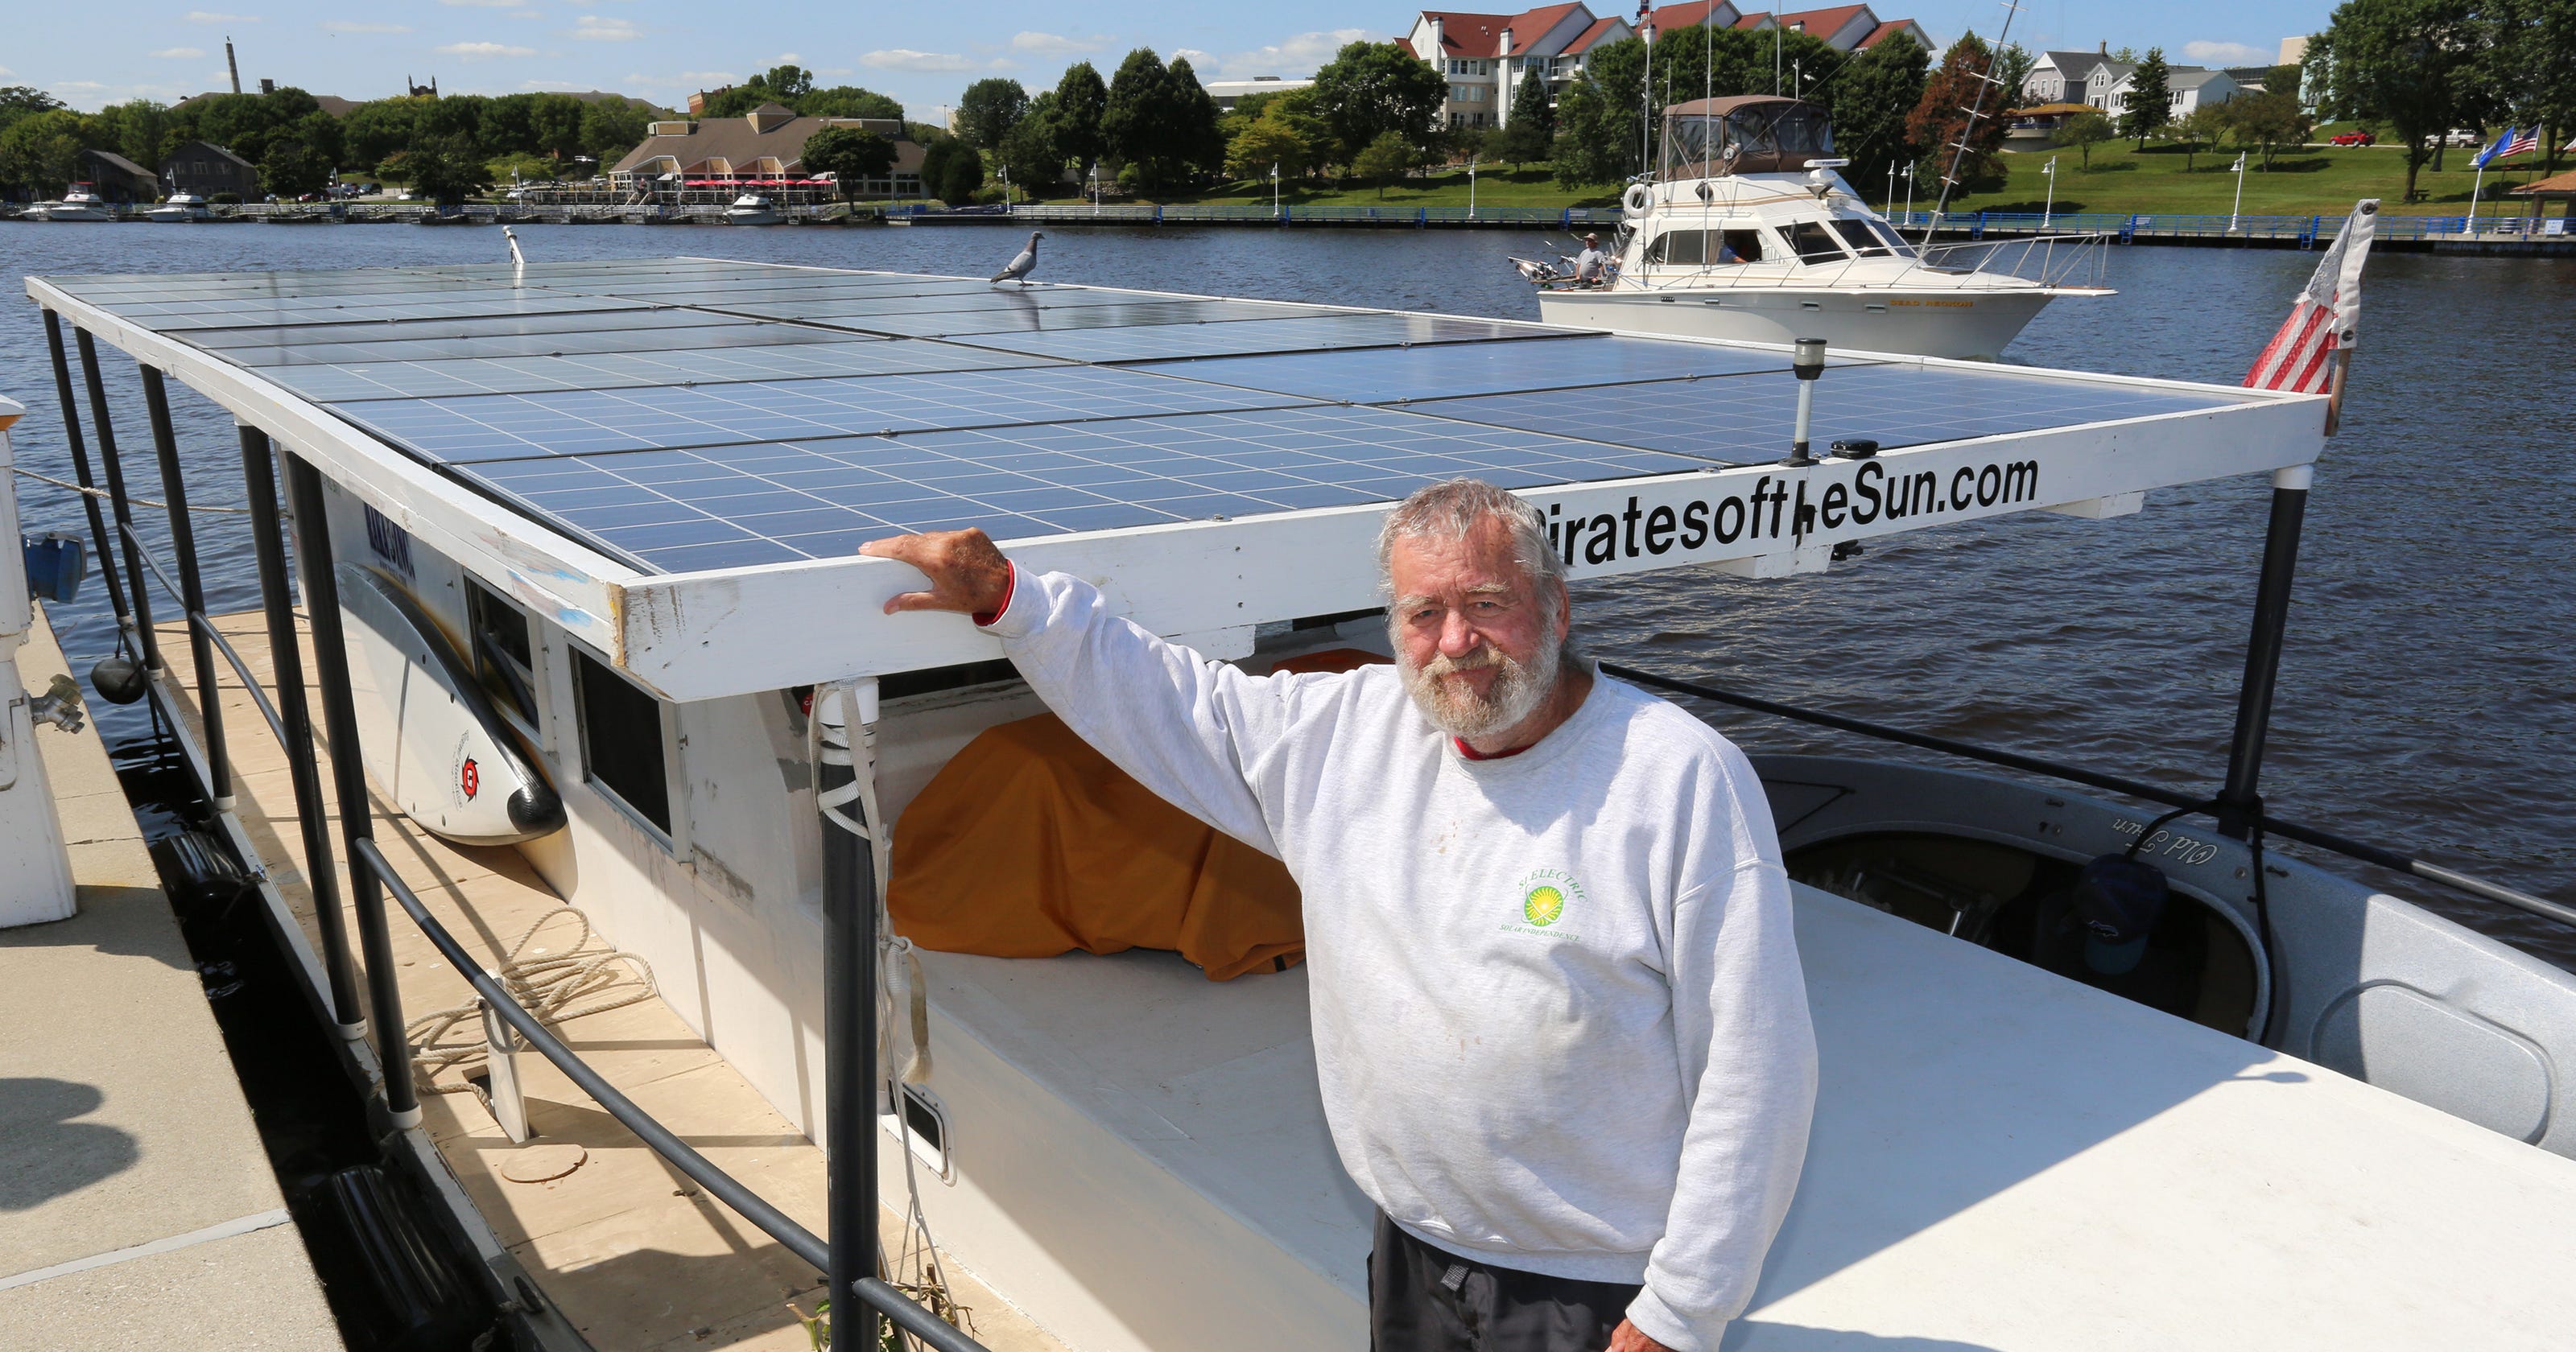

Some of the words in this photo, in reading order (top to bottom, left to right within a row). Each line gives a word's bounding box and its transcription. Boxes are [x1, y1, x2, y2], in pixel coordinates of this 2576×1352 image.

[1536, 459, 2038, 566] iratesoftheSun.com
[2112, 818, 2169, 853] Twn
[2163, 835, 2218, 865] Old
[1530, 868, 1587, 902] ELECTRIC
[1499, 924, 1522, 934] SOLAR
[1523, 927, 1581, 942] INDEPENDENCE
